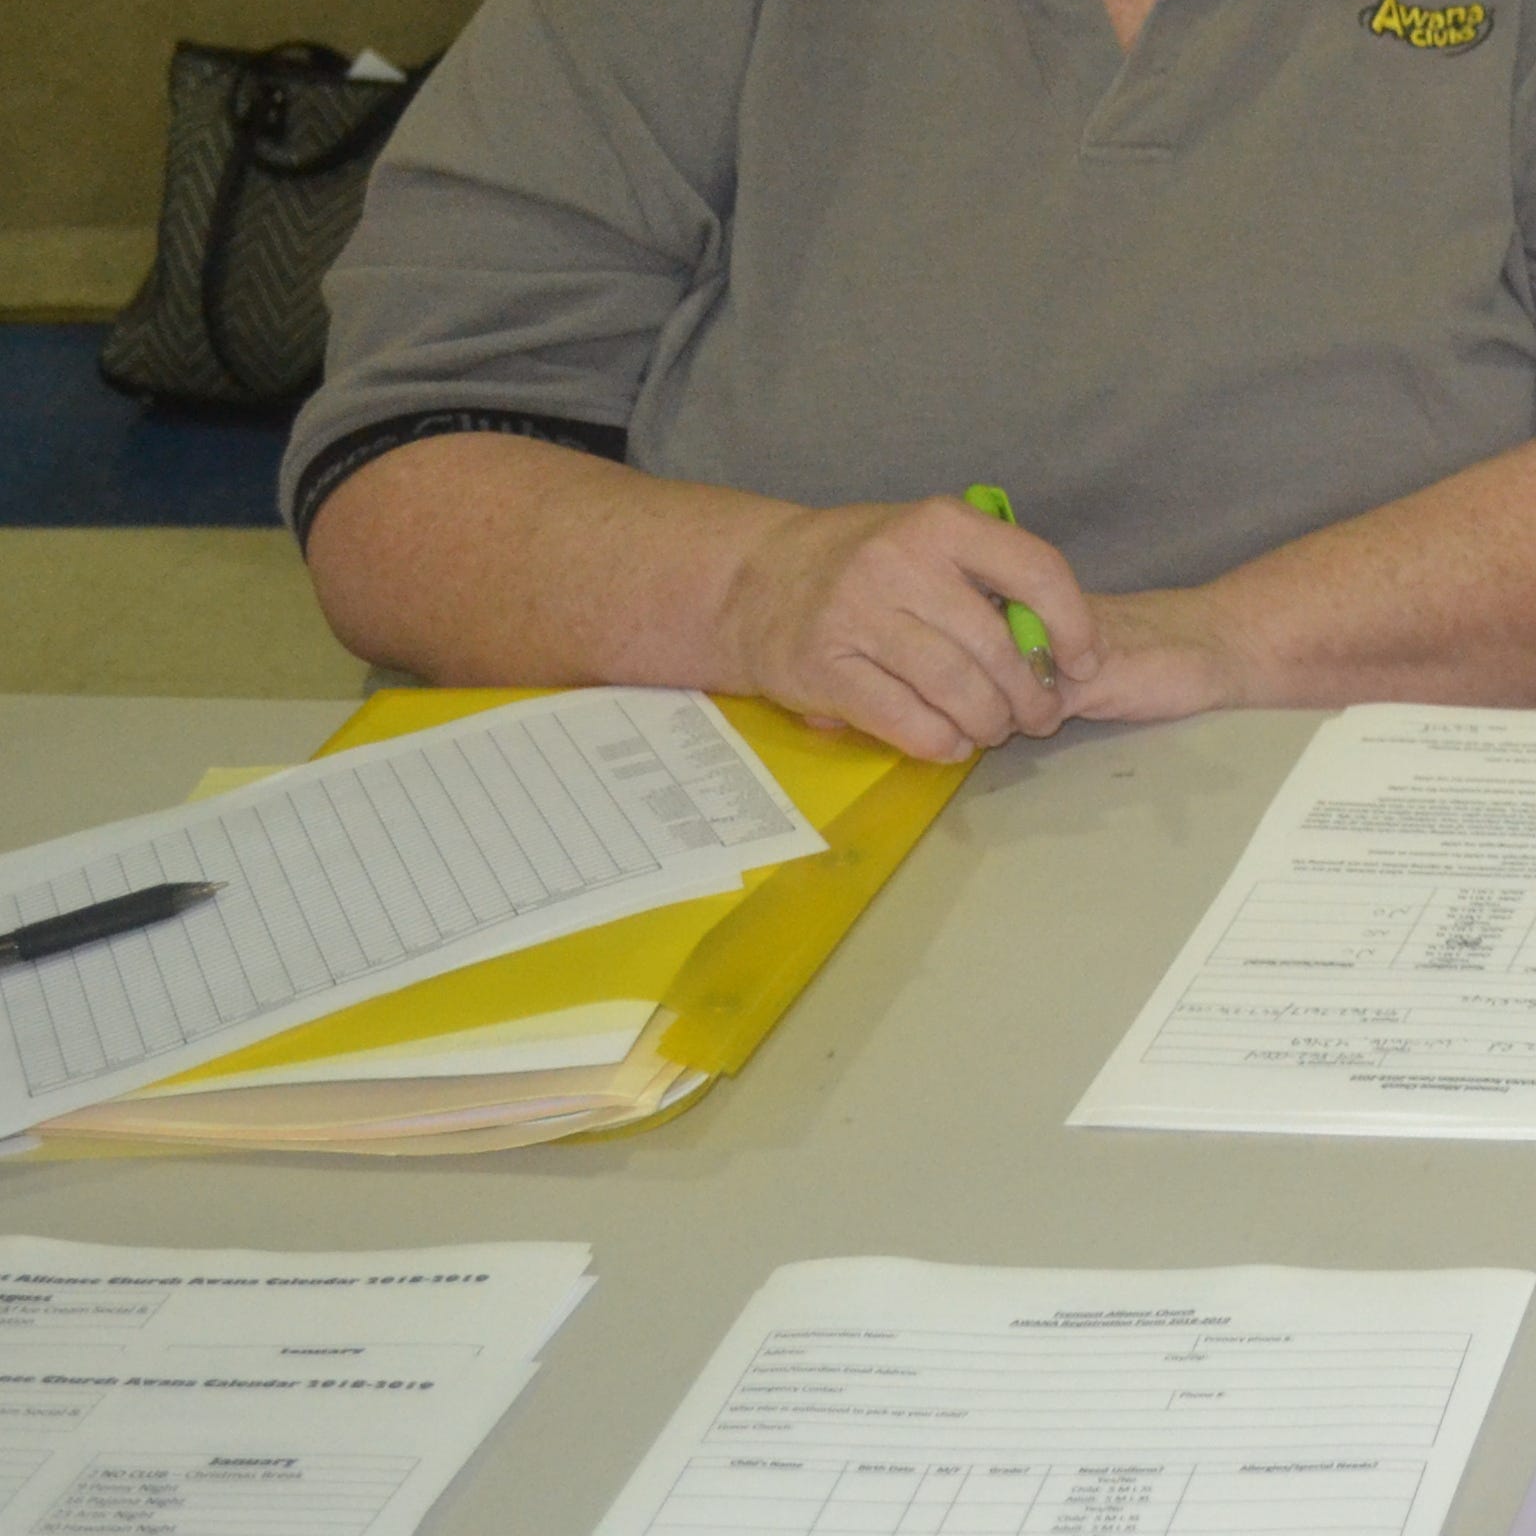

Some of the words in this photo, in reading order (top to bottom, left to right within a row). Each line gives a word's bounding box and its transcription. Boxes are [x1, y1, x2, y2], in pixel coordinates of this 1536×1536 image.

[107, 1275, 182, 1286] Church
[187, 1276, 259, 1286] Awana
[265, 1276, 359, 1287] Calendar
[203, 1378, 301, 1390] Calendar
